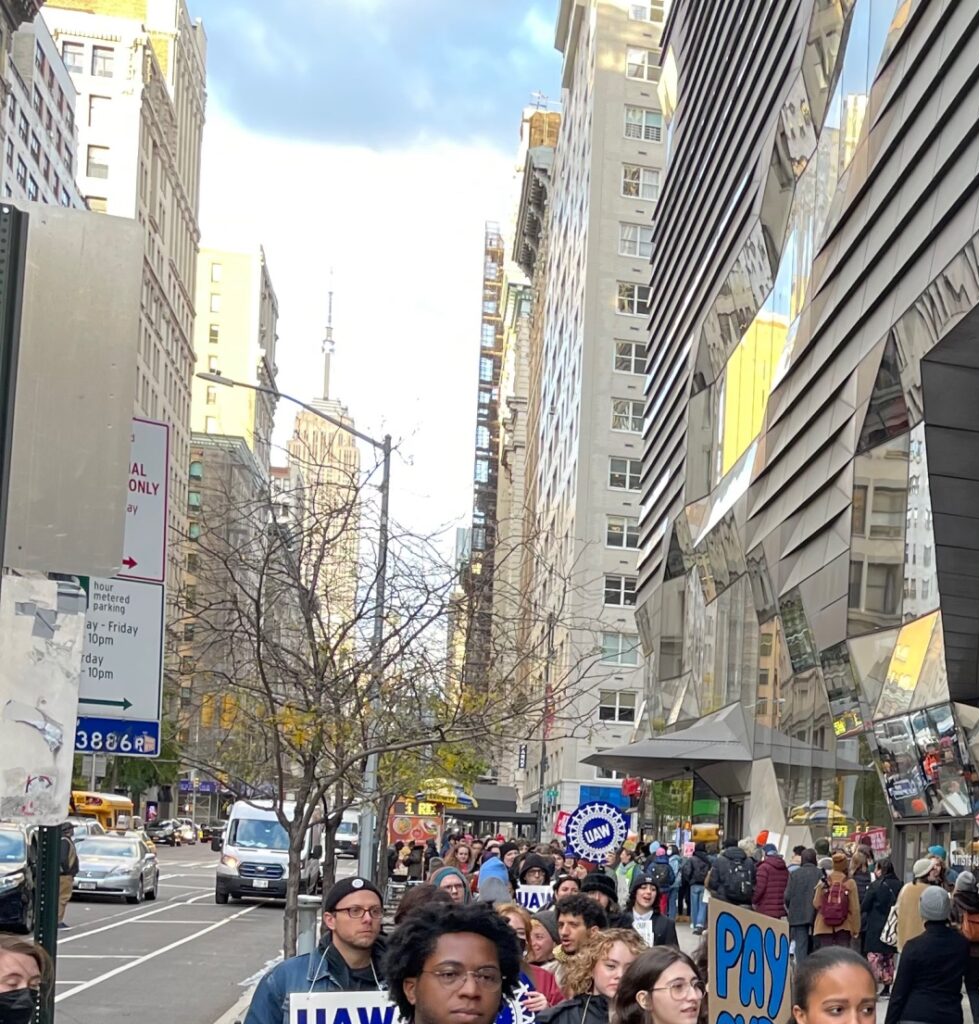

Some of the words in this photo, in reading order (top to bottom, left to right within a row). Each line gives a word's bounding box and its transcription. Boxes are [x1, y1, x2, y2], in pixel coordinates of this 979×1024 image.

[128, 479, 160, 496] ONLY
[93, 581, 114, 592] hour
[93, 592, 131, 605] metered
[93, 603, 126, 615] parking
[108, 621, 138, 637] Friday
[88, 632, 114, 646] 10pm
[88, 667, 114, 680] 10pm
[584, 823, 611, 844] UAW
[715, 911, 789, 1020] PAY
